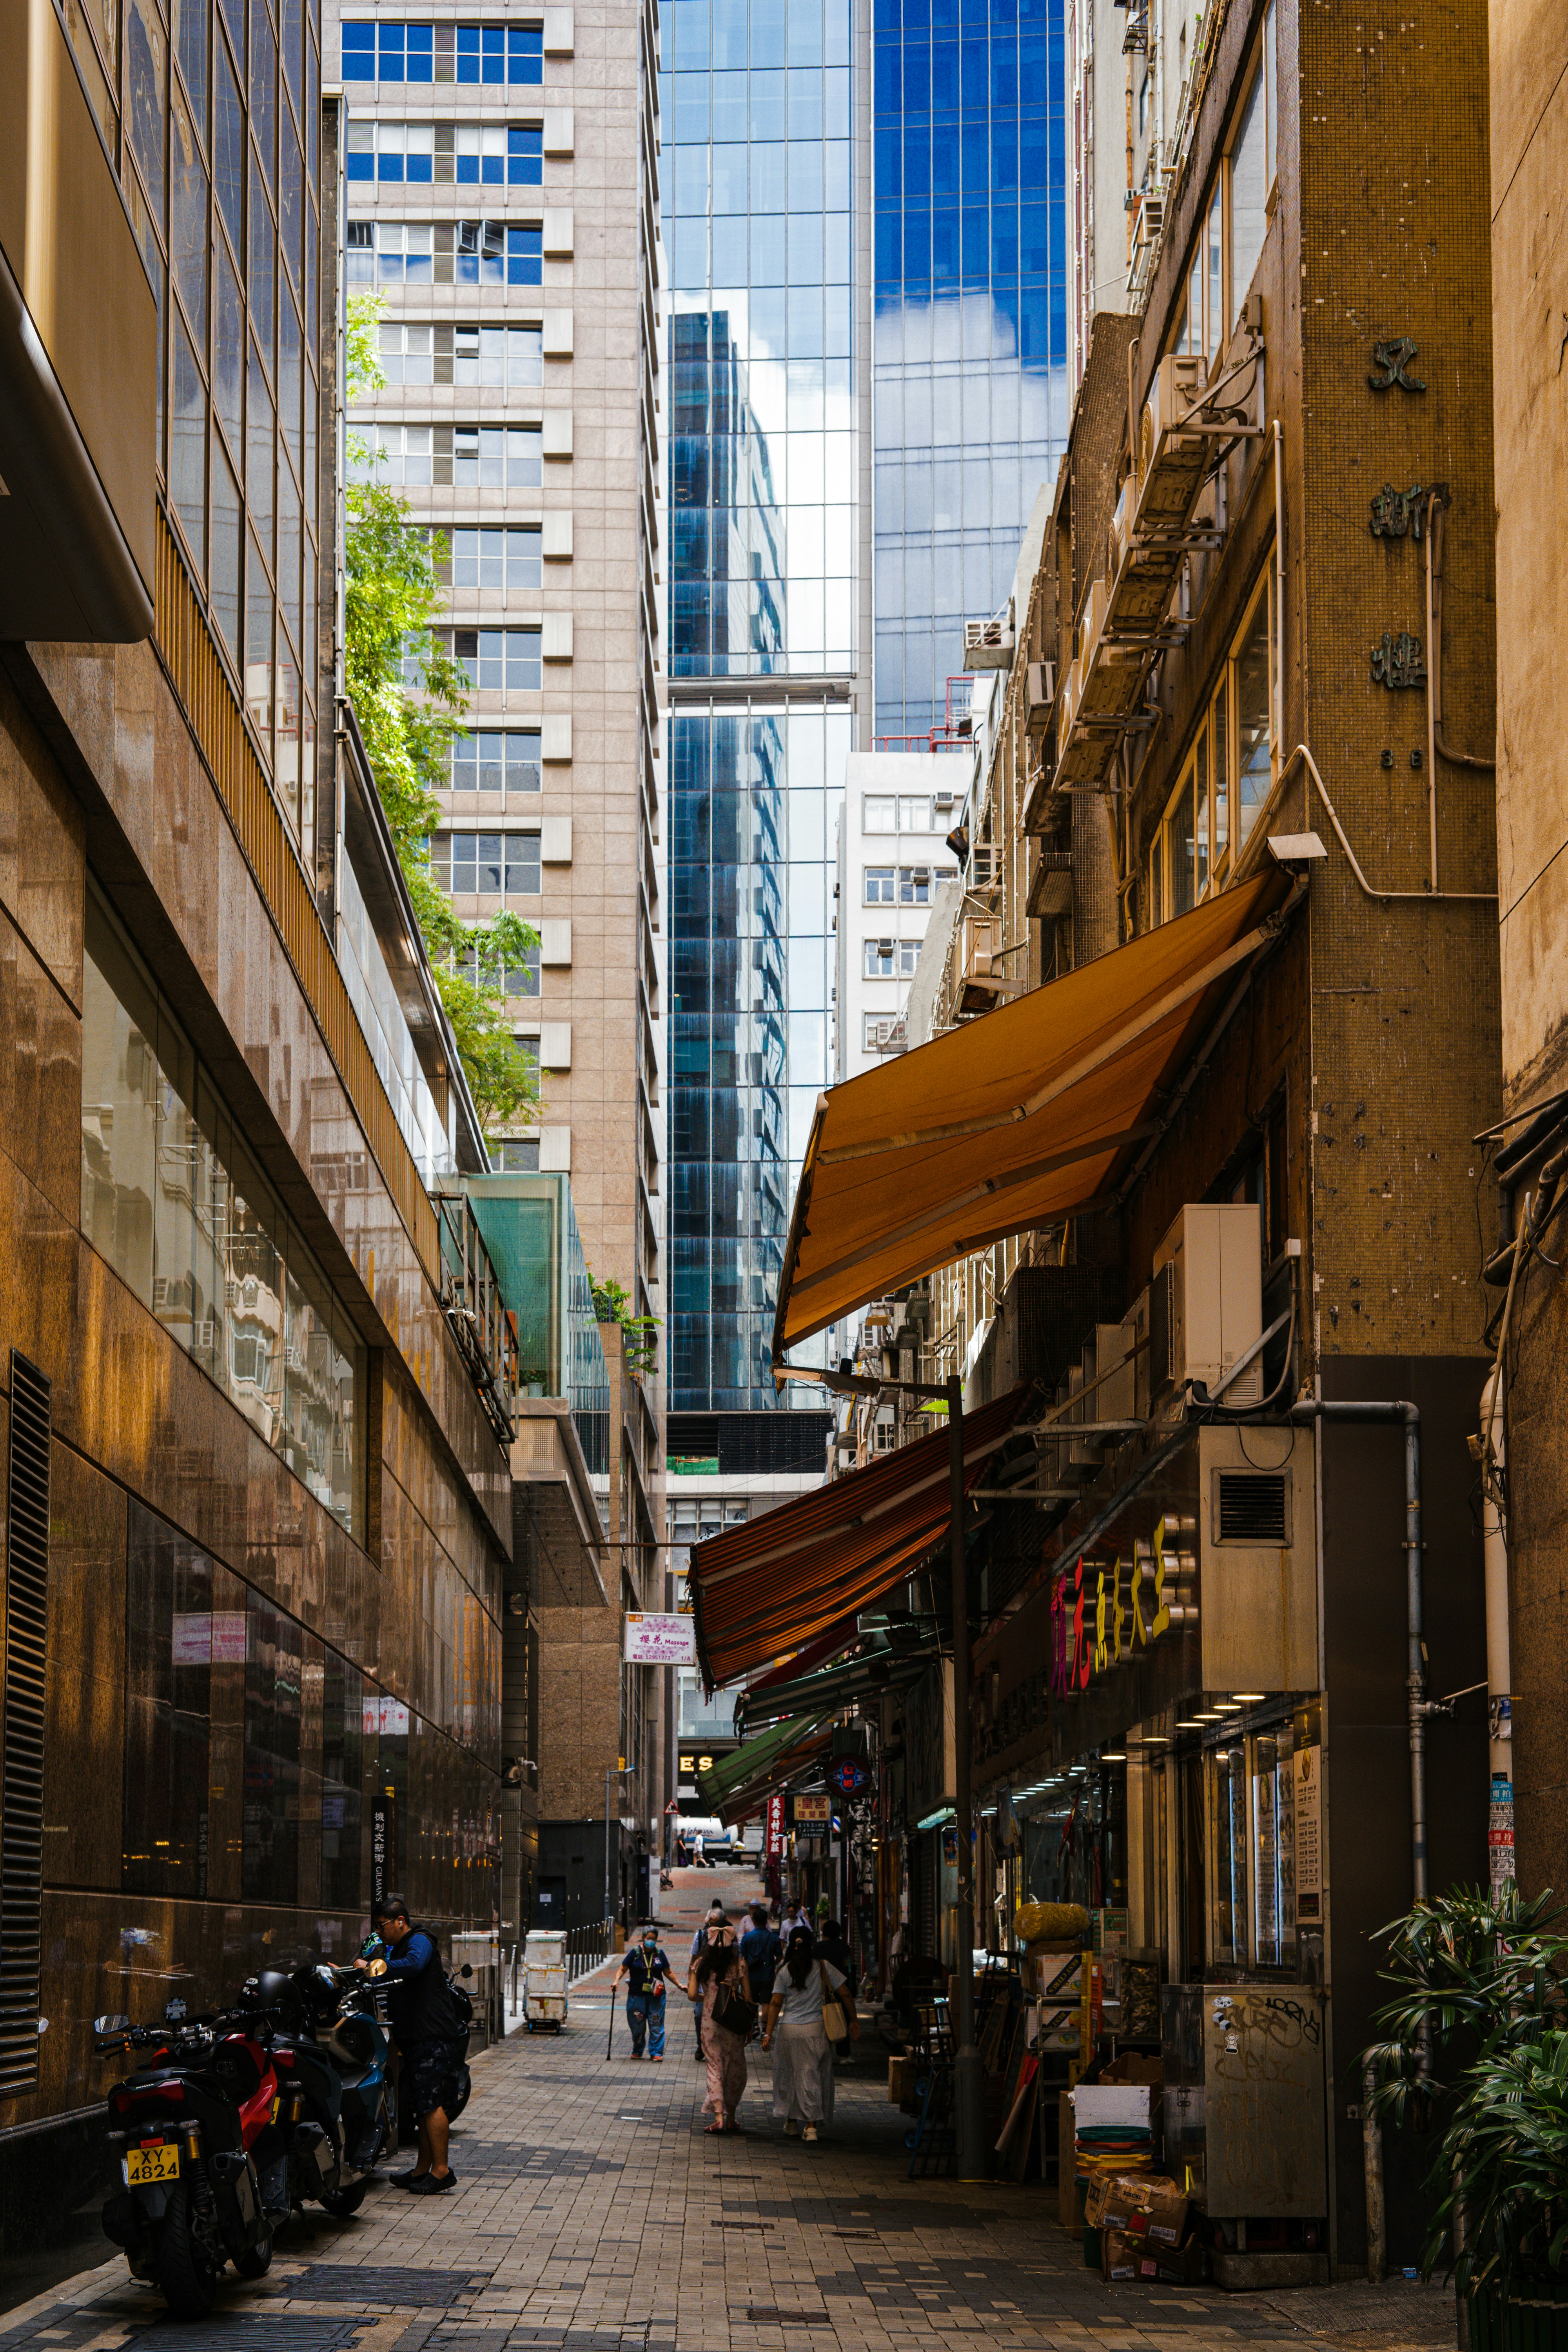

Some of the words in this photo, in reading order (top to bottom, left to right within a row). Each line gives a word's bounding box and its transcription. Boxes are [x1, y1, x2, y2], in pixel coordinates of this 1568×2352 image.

[1367, 336, 1427, 691] 又新樓
[639, 1634, 662, 1645] 櫻花
[802, 1797, 826, 1809] 皇宮
[374, 1811, 385, 1863] 機利文新街
[1066, 1958, 1079, 1973] BEST
[141, 2149, 164, 2165] XY
[129, 2162, 178, 2181] 4824
